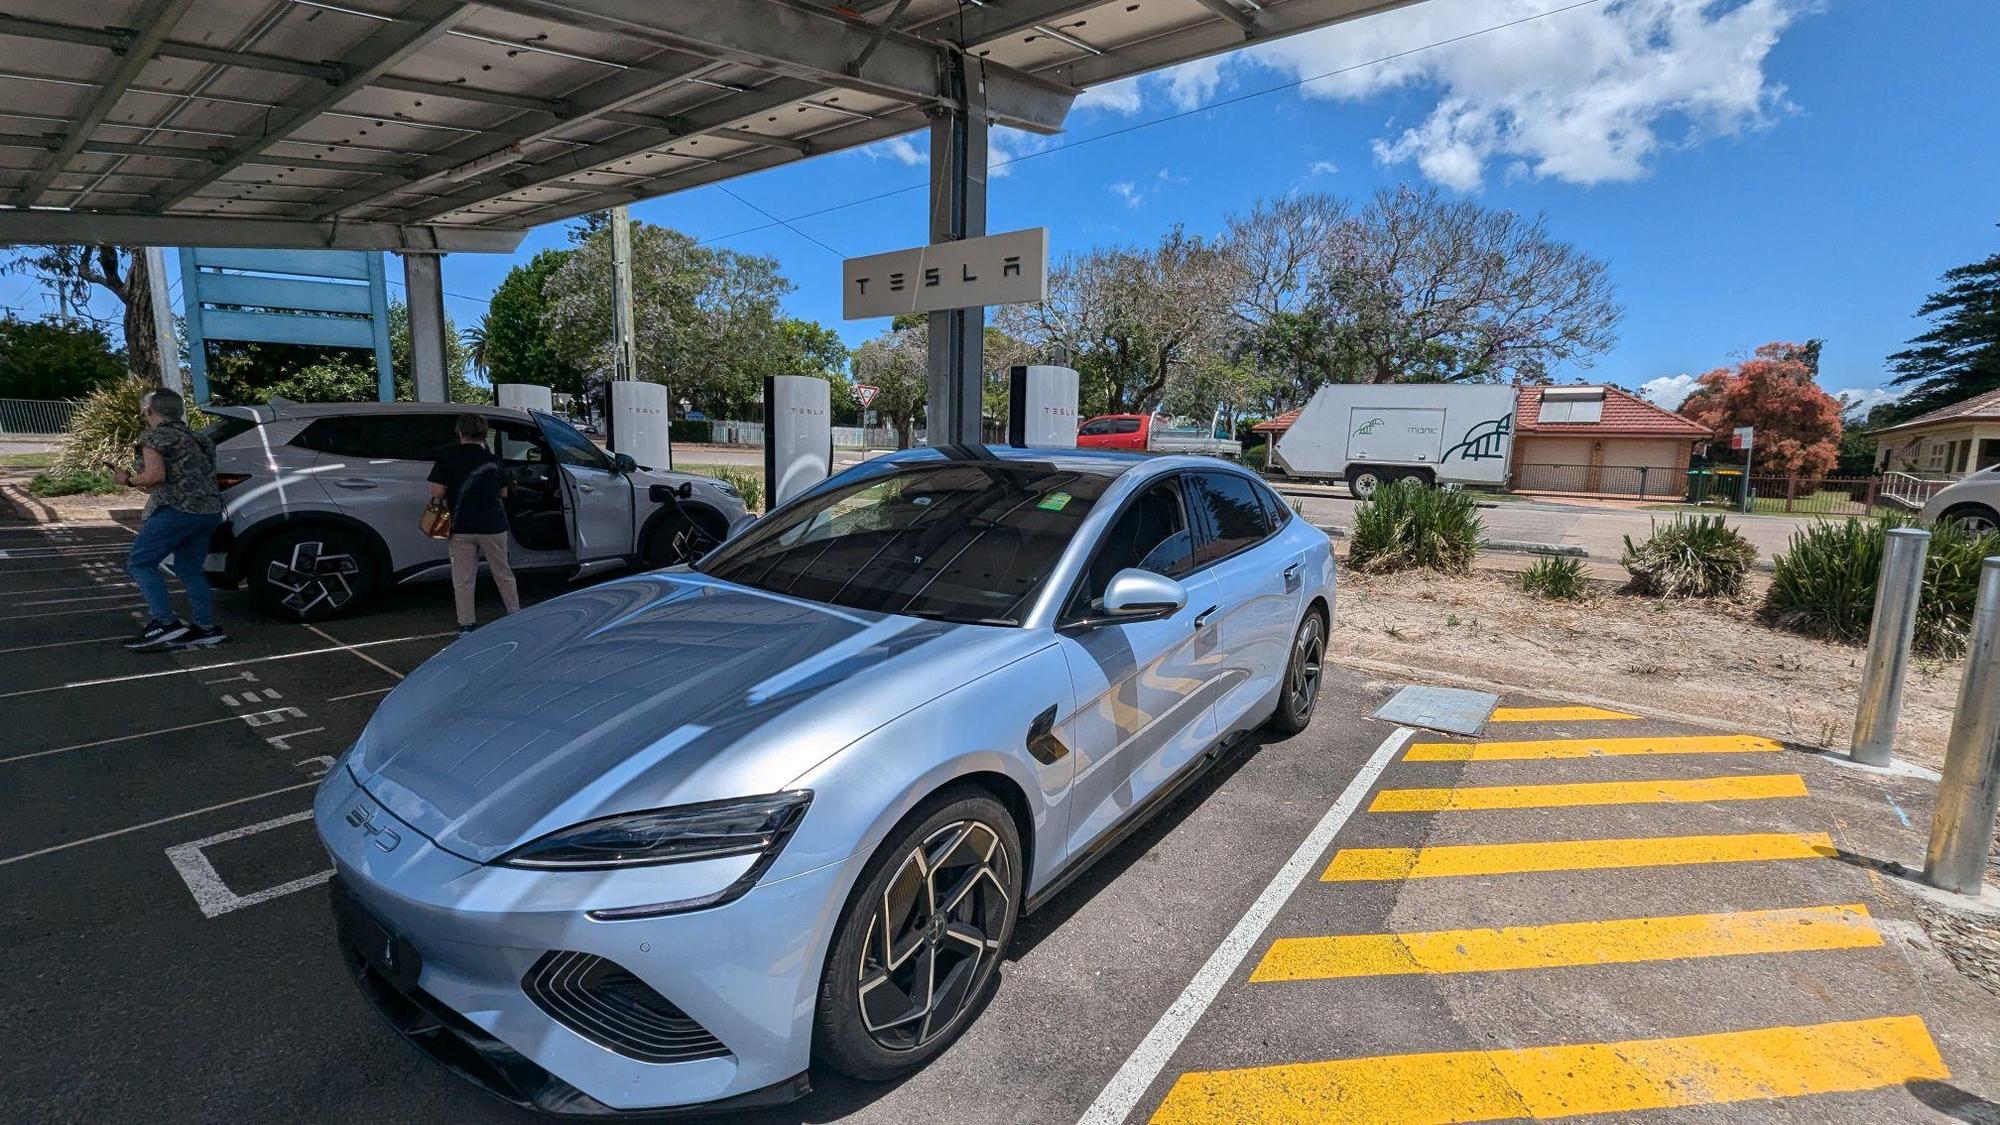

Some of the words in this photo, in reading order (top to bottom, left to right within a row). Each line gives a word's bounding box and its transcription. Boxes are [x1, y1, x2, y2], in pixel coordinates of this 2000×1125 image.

[856, 256, 1020, 295] TESLA
[1408, 426, 1438, 435] manic
[345, 804, 401, 853] BYD
